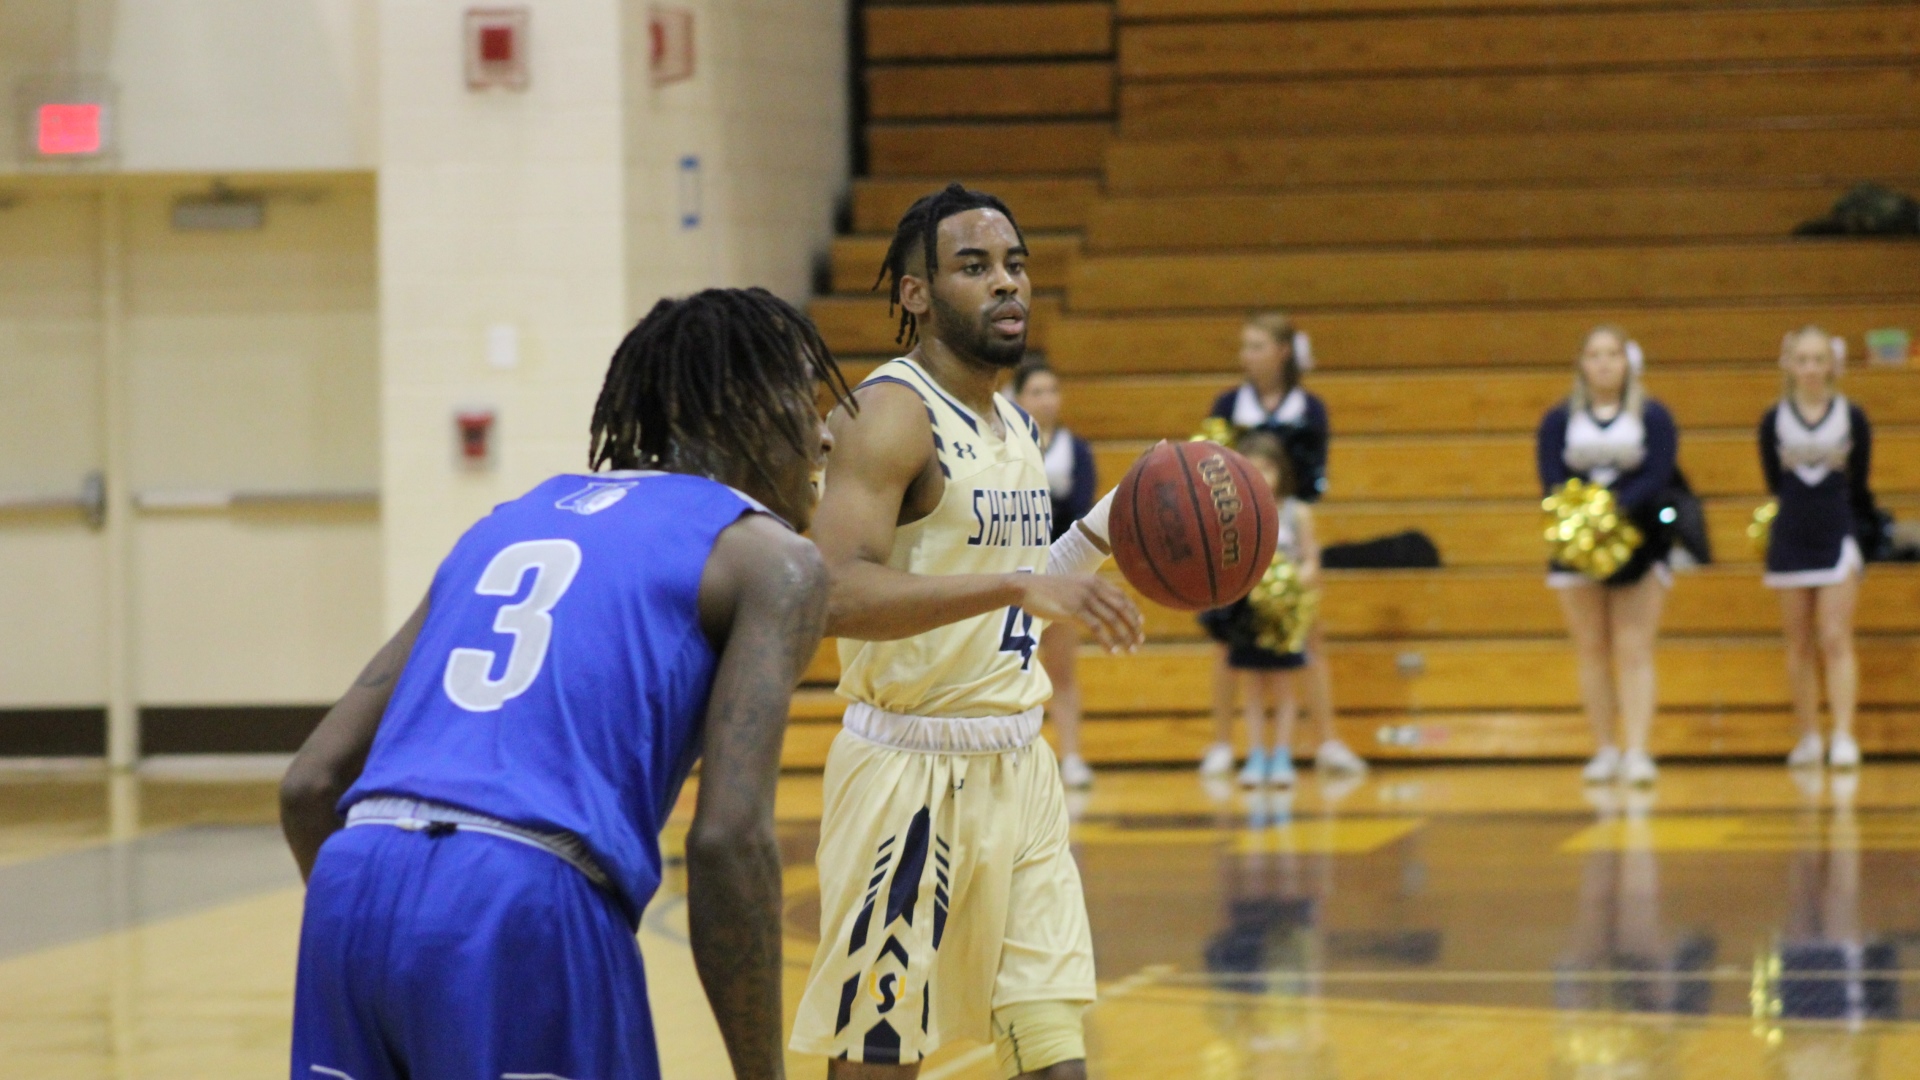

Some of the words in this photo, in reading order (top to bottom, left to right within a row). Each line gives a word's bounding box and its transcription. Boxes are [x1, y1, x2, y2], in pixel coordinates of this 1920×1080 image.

[1197, 454, 1242, 570] Wilson
[443, 538, 582, 712] 3
[998, 567, 1037, 674] 4
